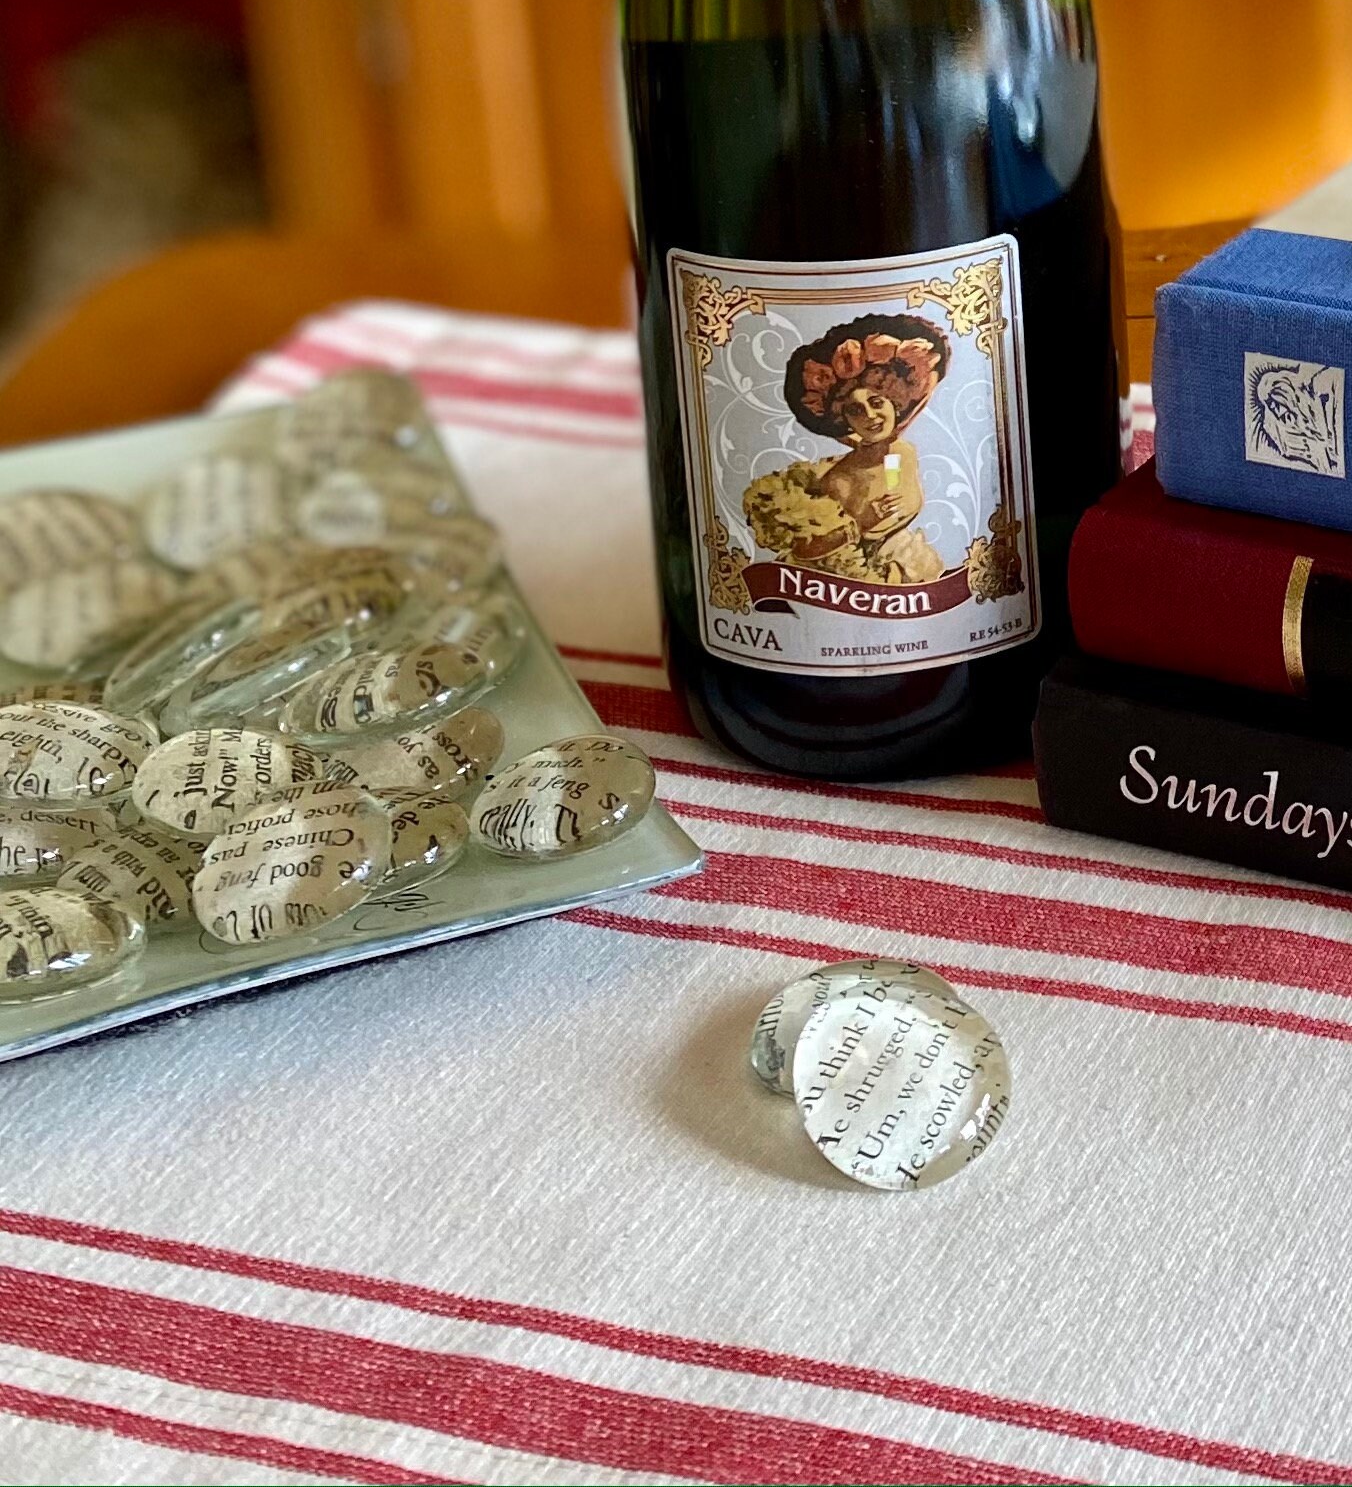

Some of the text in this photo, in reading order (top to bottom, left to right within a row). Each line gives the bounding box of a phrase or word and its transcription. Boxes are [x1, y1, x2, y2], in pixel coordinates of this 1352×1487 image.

[779, 566, 932, 616] Naveran
[713, 618, 783, 652] CAVA
[821, 640, 929, 657] SPARKLING WINE
[174, 760, 209, 798] just
[417, 755, 440, 780] as
[271, 786, 304, 805] the
[537, 773, 592, 801] feng
[20, 810, 101, 835] dessert
[227, 812, 296, 839] profici
[262, 827, 355, 852] Chinese
[214, 863, 267, 893] feng
[269, 854, 325, 885] good
[820, 1021, 871, 1080] think
[855, 1002, 877, 1019] I
[846, 1015, 917, 1114] shrugged.
[897, 1074, 924, 1102] we
[919, 1060, 985, 1151] scowled,
